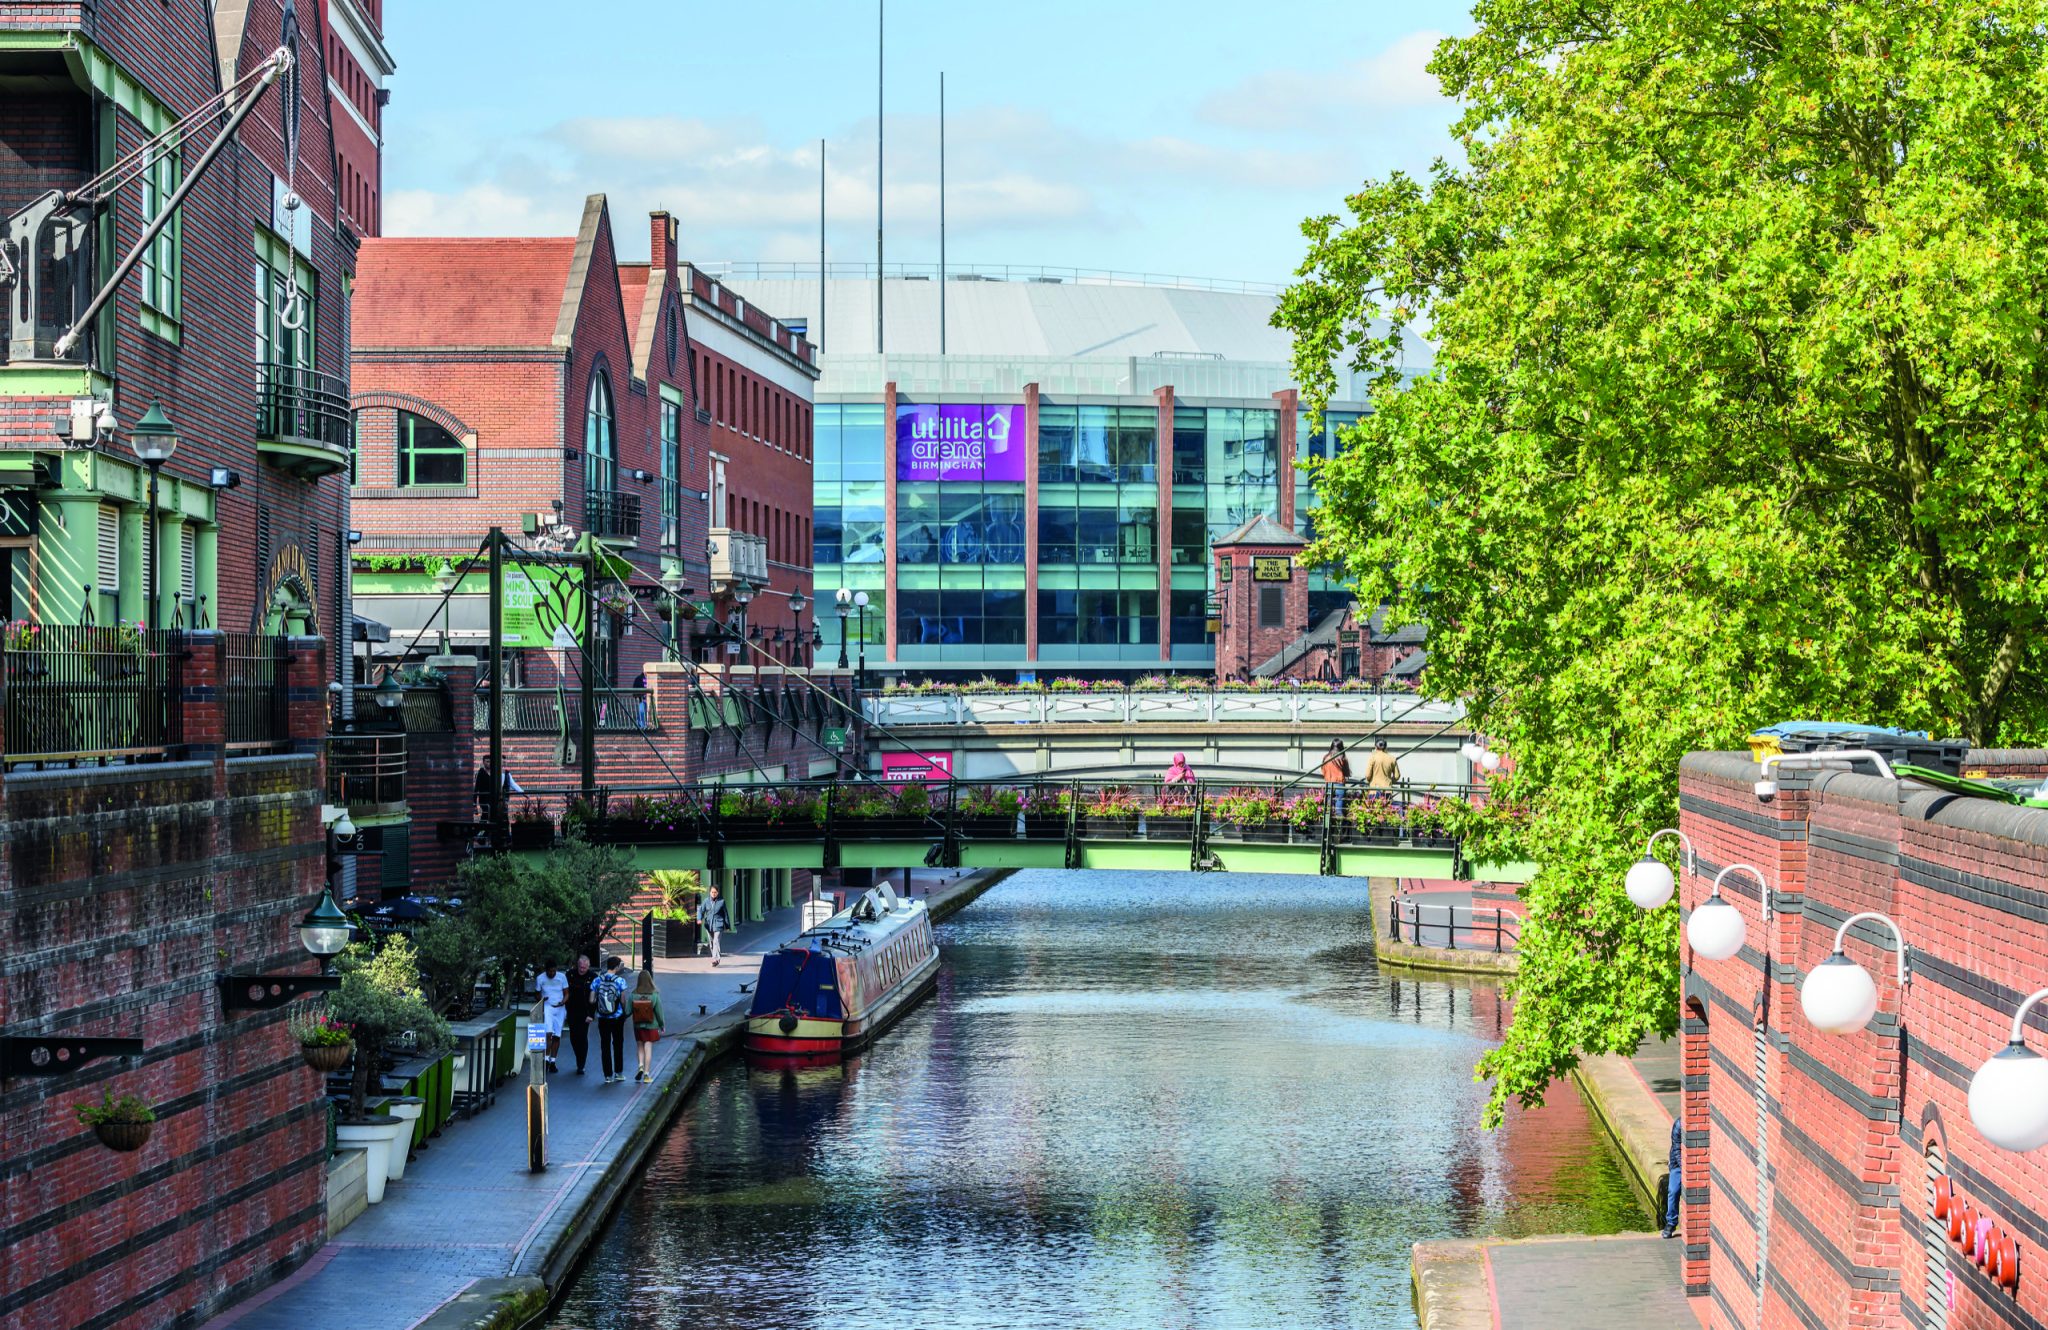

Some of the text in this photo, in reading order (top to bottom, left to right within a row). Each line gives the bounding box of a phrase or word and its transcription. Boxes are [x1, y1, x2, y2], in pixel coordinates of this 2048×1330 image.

[911, 416, 985, 440] utilita
[911, 440, 986, 460] arena
[911, 461, 986, 470] BIRMINGHAM
[512, 593, 533, 607] SOUL
